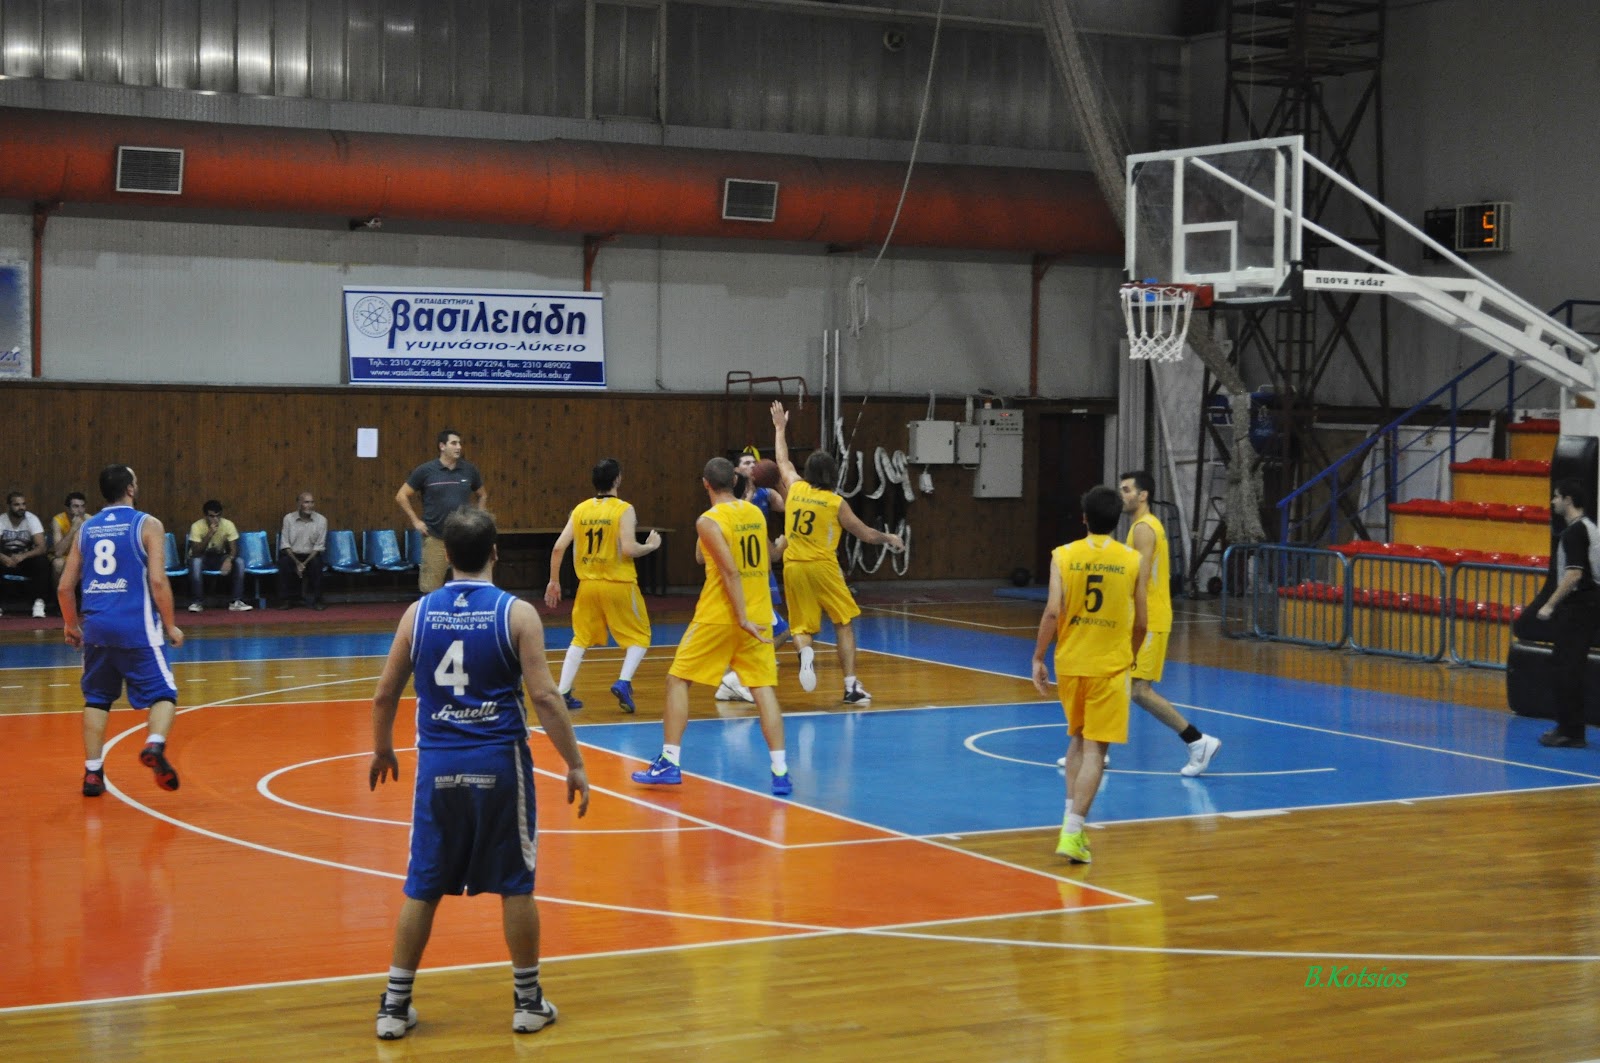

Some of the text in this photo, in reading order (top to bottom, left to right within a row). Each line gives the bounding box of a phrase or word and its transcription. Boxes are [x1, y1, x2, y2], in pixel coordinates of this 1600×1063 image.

[1482, 210, 1498, 243] 5
[1315, 276, 1385, 287] nuova radar
[414, 297, 474, 305] ΕΚΠΑΙΔΕΥΤΗΡΙΑ
[387, 298, 587, 350] βασιλειάδη
[405, 338, 587, 352] γυμνάσιο-λύκειο
[389, 359, 411, 367] 2310
[453, 360, 473, 368] 2310
[522, 361, 541, 369] 2310
[792, 508, 816, 536] 13
[585, 527, 604, 555] 11
[739, 533, 761, 569] 10
[94, 539, 117, 575] 8
[1084, 574, 1104, 613] 5
[434, 640, 470, 696] 4
